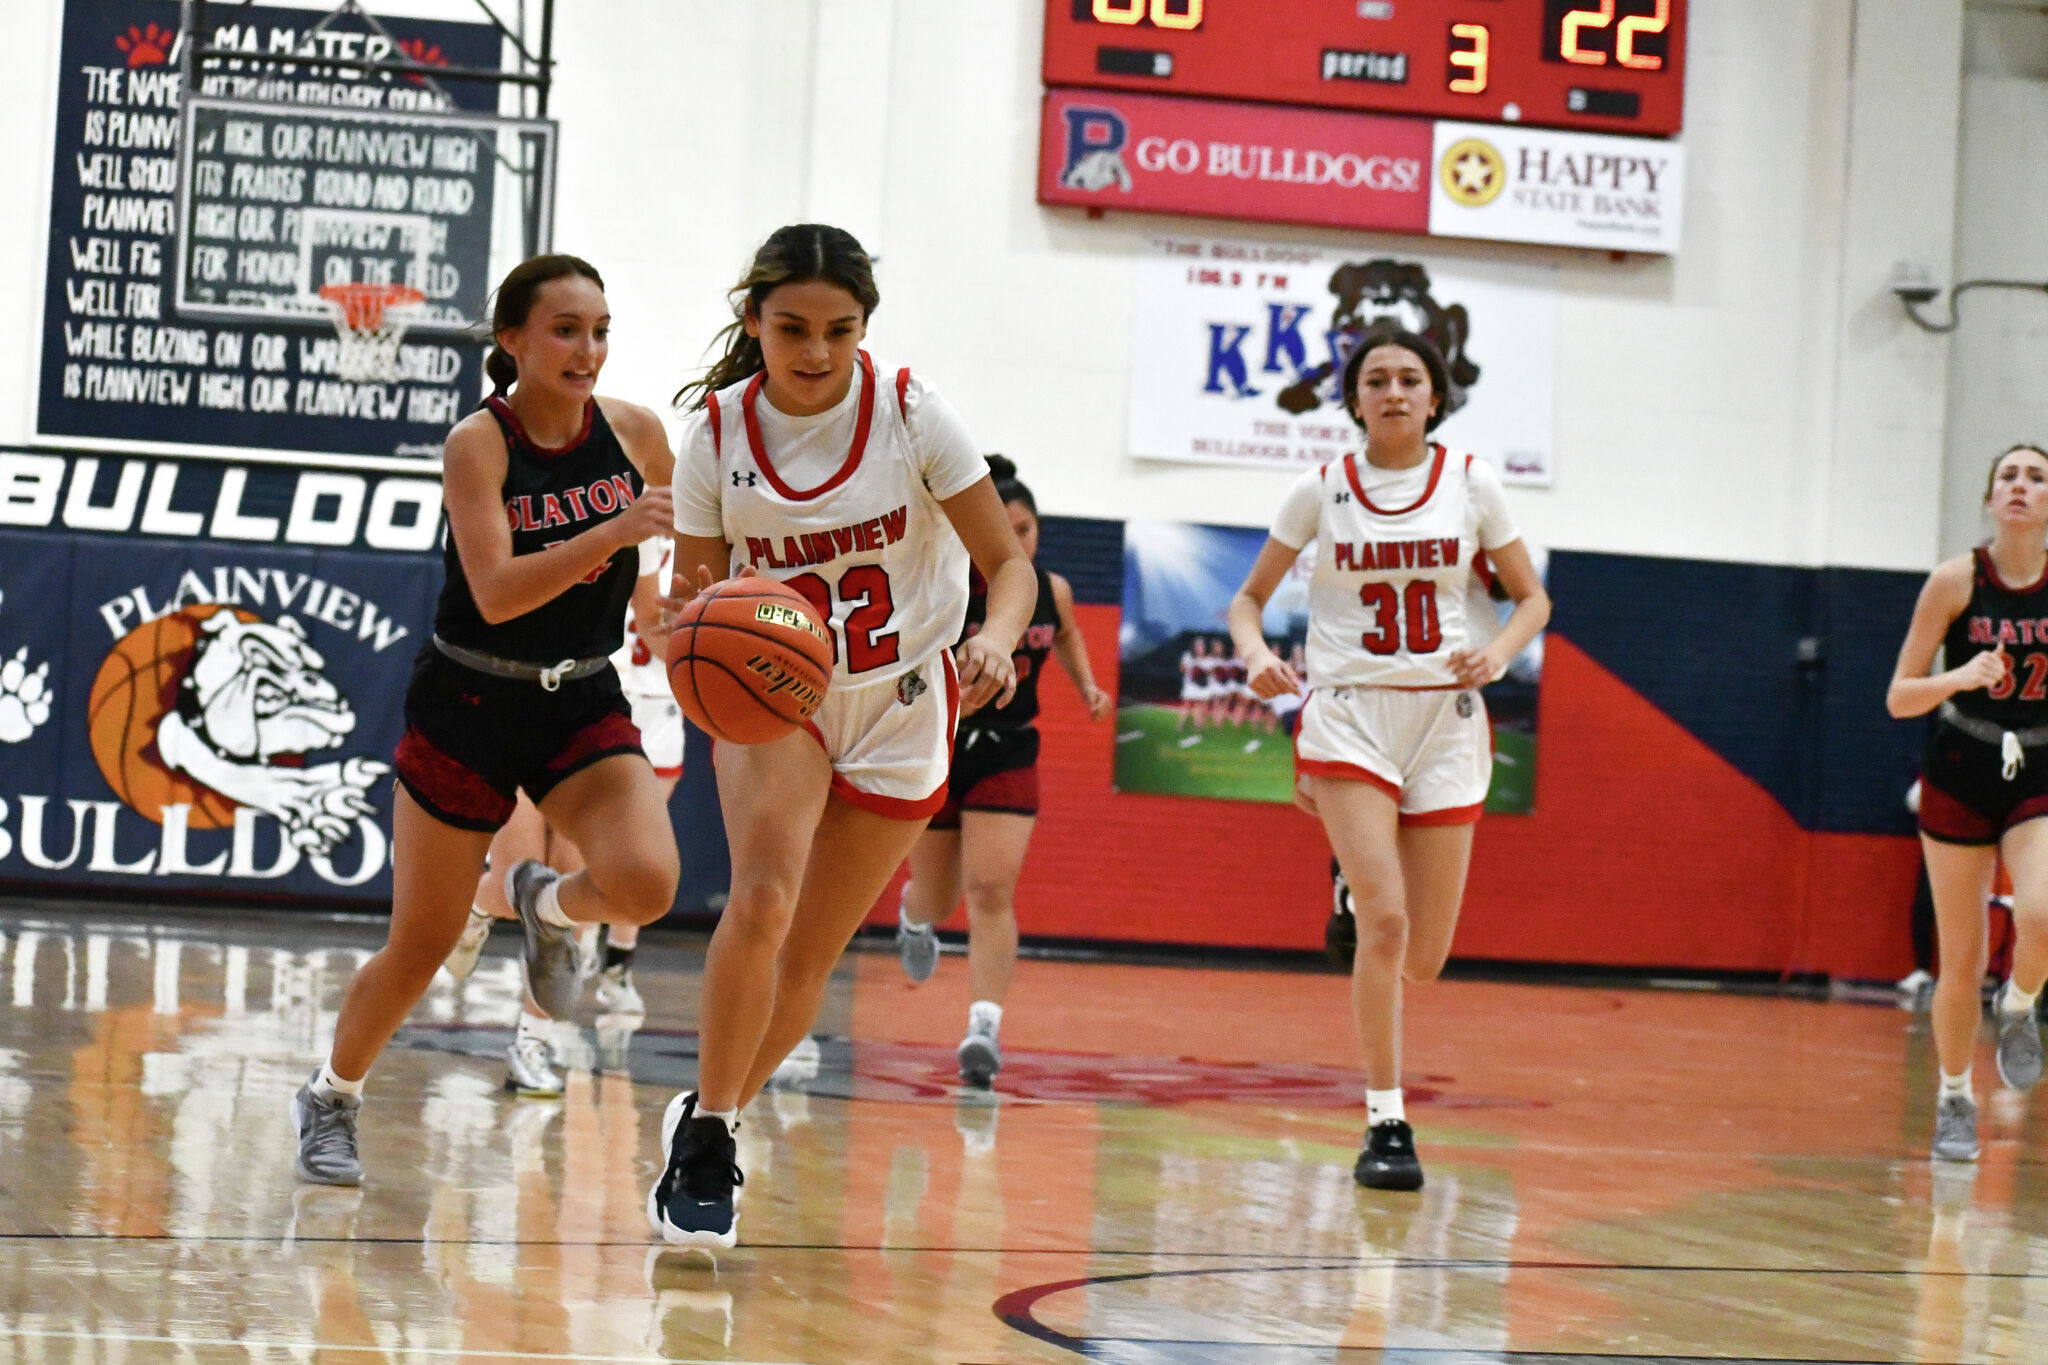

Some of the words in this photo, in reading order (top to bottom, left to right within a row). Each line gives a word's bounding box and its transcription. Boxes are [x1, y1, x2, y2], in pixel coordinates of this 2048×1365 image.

[1449, 24, 1489, 94] 3
[1559, 0, 1670, 69] 22
[81, 66, 125, 105] THE
[1322, 51, 1407, 82] period
[84, 110, 106, 146] IS
[272, 123, 315, 160] OUR
[316, 127, 430, 168] PLAINVIEW
[1136, 137, 1200, 174] GO
[1207, 142, 1421, 192] BULLDOGS!
[129, 156, 178, 193] SHOU
[1518, 147, 1668, 191] HAPPY
[192, 245, 229, 282] FOR
[64, 320, 127, 361] WHILE
[131, 325, 209, 366] BLAZING
[214, 331, 244, 368] ON
[251, 332, 288, 371] OUR
[63, 363, 82, 399] IS
[85, 365, 192, 405] PLAINVIEW
[198, 373, 246, 412] HIGH
[250, 376, 290, 413] OUR
[295, 379, 405, 420] PLAINVIEW
[407, 387, 461, 424] HIGH
[0, 452, 447, 552] BULLDO
[506, 471, 636, 532] SLATON
[745, 505, 907, 569] PLAINVIEW
[1334, 537, 1460, 571] PLAINVIEW
[99, 566, 407, 653] PLAINVIEW
[1360, 579, 1443, 656] 30
[0, 794, 394, 887] ULLDO
